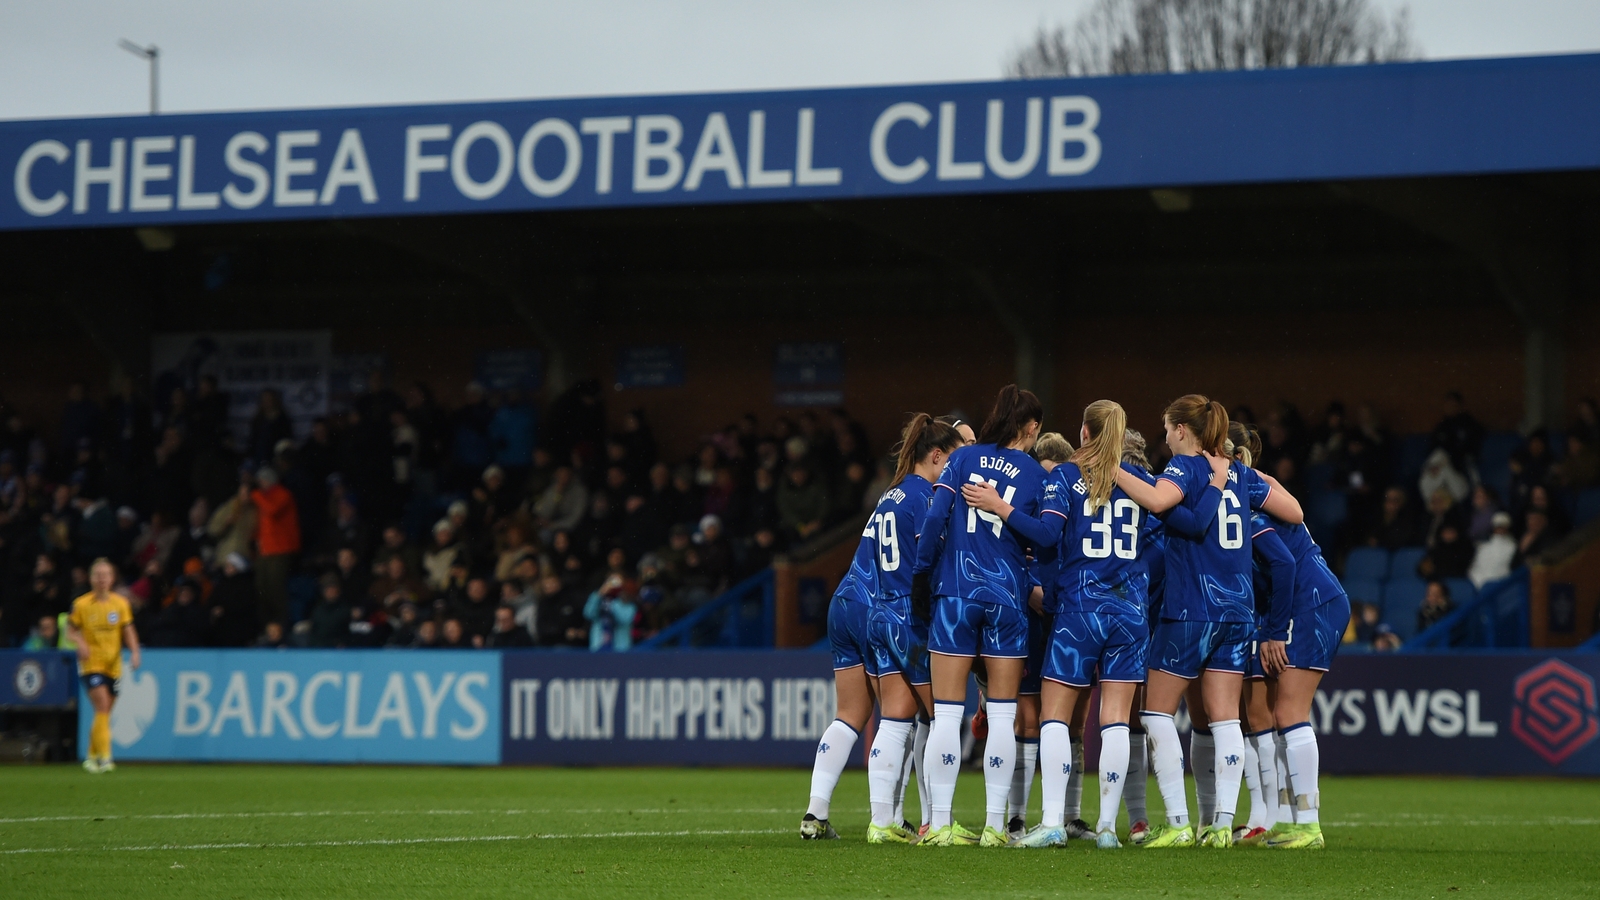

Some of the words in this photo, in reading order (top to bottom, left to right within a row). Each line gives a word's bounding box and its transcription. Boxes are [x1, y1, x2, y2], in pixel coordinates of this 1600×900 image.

[14, 128, 378, 217] CHELSEA
[404, 107, 842, 201] FOOTBALL
[869, 95, 1102, 183] CLUB
[980, 456, 1020, 479] BJÖRN
[875, 511, 900, 572] 19
[1082, 498, 1140, 560] 33
[1217, 489, 1241, 550] 6
[172, 670, 489, 741] BARCLAYS
[509, 678, 542, 740] IT
[545, 677, 620, 740] ONLY
[625, 677, 766, 741] HAPPENS
[1372, 688, 1498, 737] WSL
